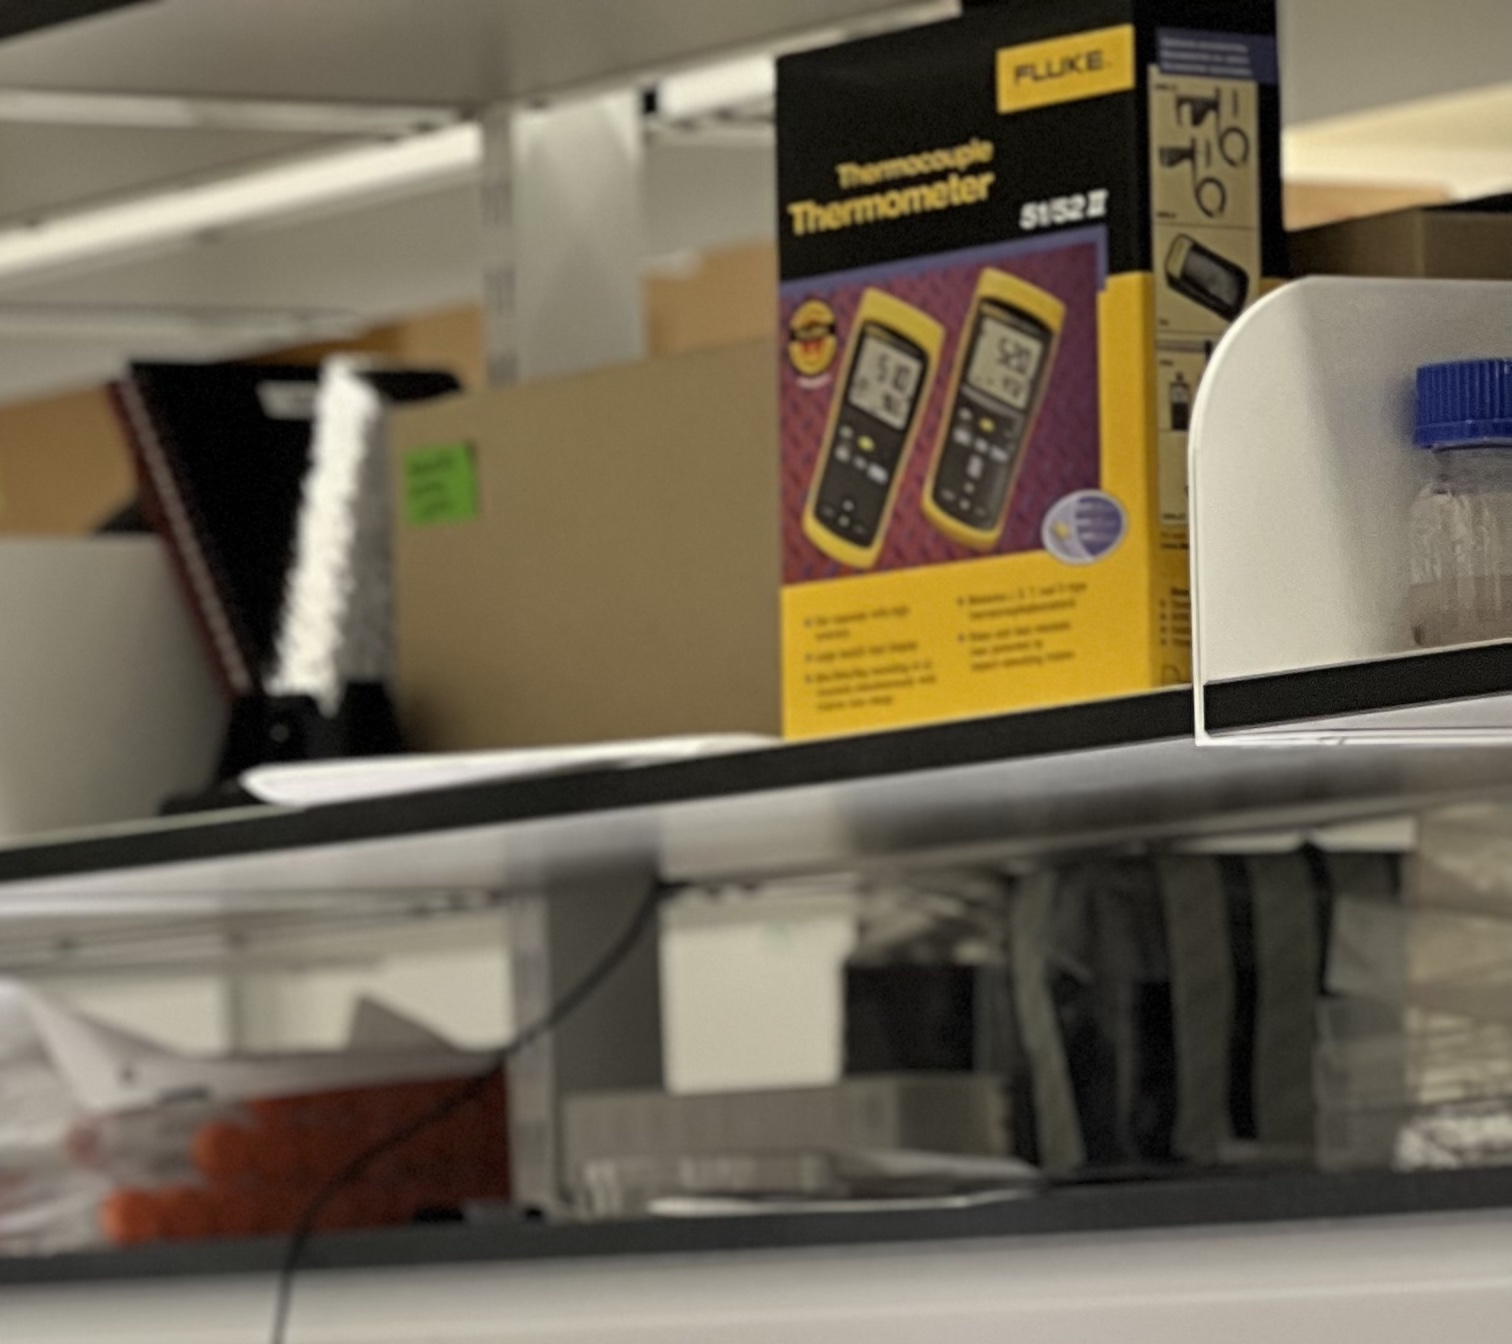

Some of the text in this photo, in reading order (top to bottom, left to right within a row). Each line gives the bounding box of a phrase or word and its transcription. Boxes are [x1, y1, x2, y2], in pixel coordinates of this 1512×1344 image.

[1014, 50, 1104, 84] FLUKE
[835, 138, 994, 189] Thermocouple
[788, 172, 995, 235] Thermometer
